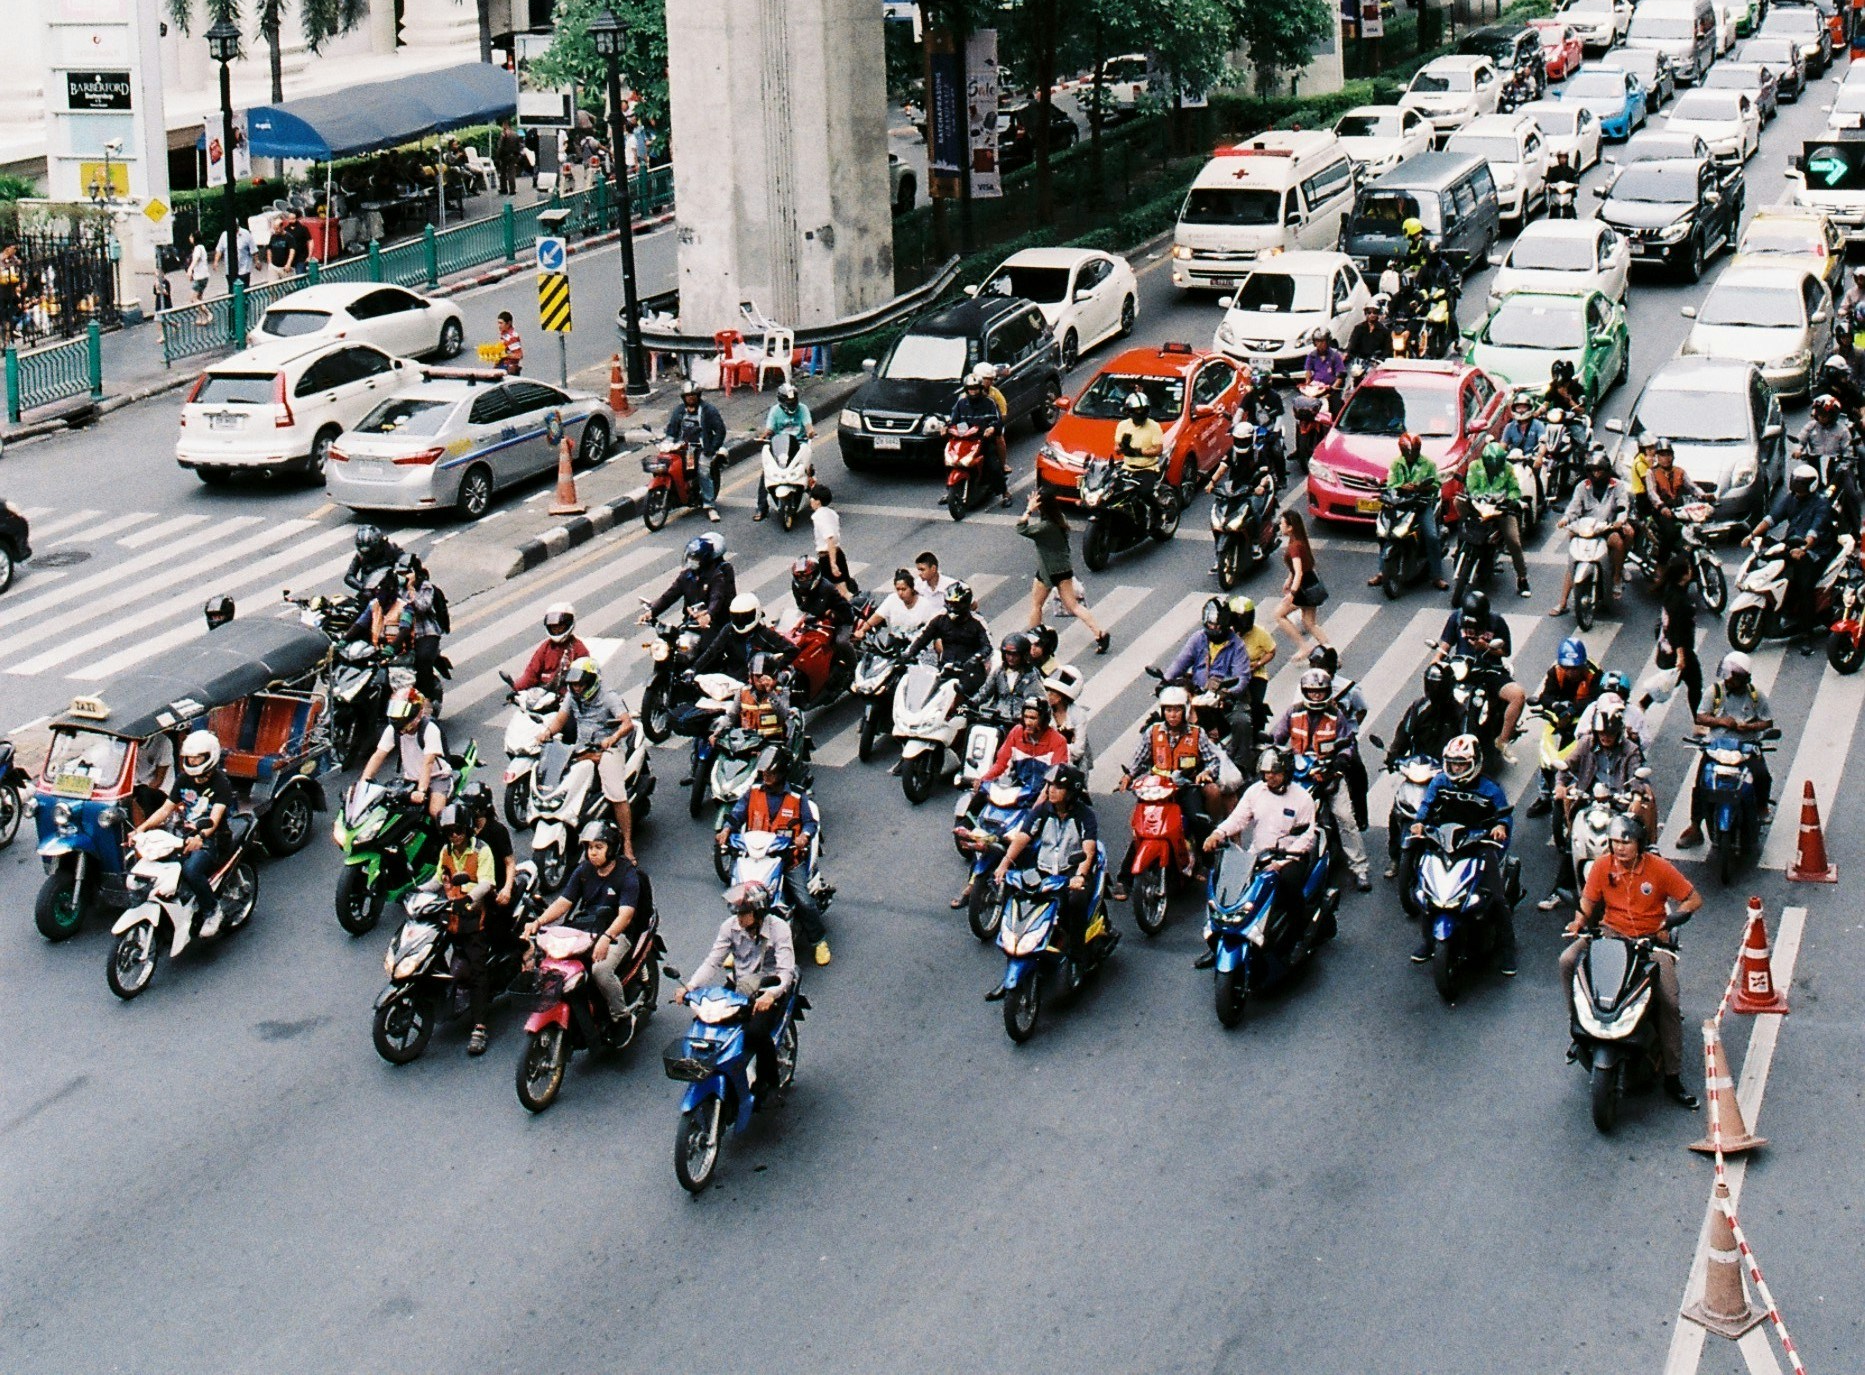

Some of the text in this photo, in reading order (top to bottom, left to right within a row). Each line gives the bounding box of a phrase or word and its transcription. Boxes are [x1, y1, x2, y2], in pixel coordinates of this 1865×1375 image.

[70, 82, 129, 96] BARBERFORD
[967, 80, 995, 98] Sale
[977, 183, 994, 191] VISA
[74, 700, 96, 713] TAXI
